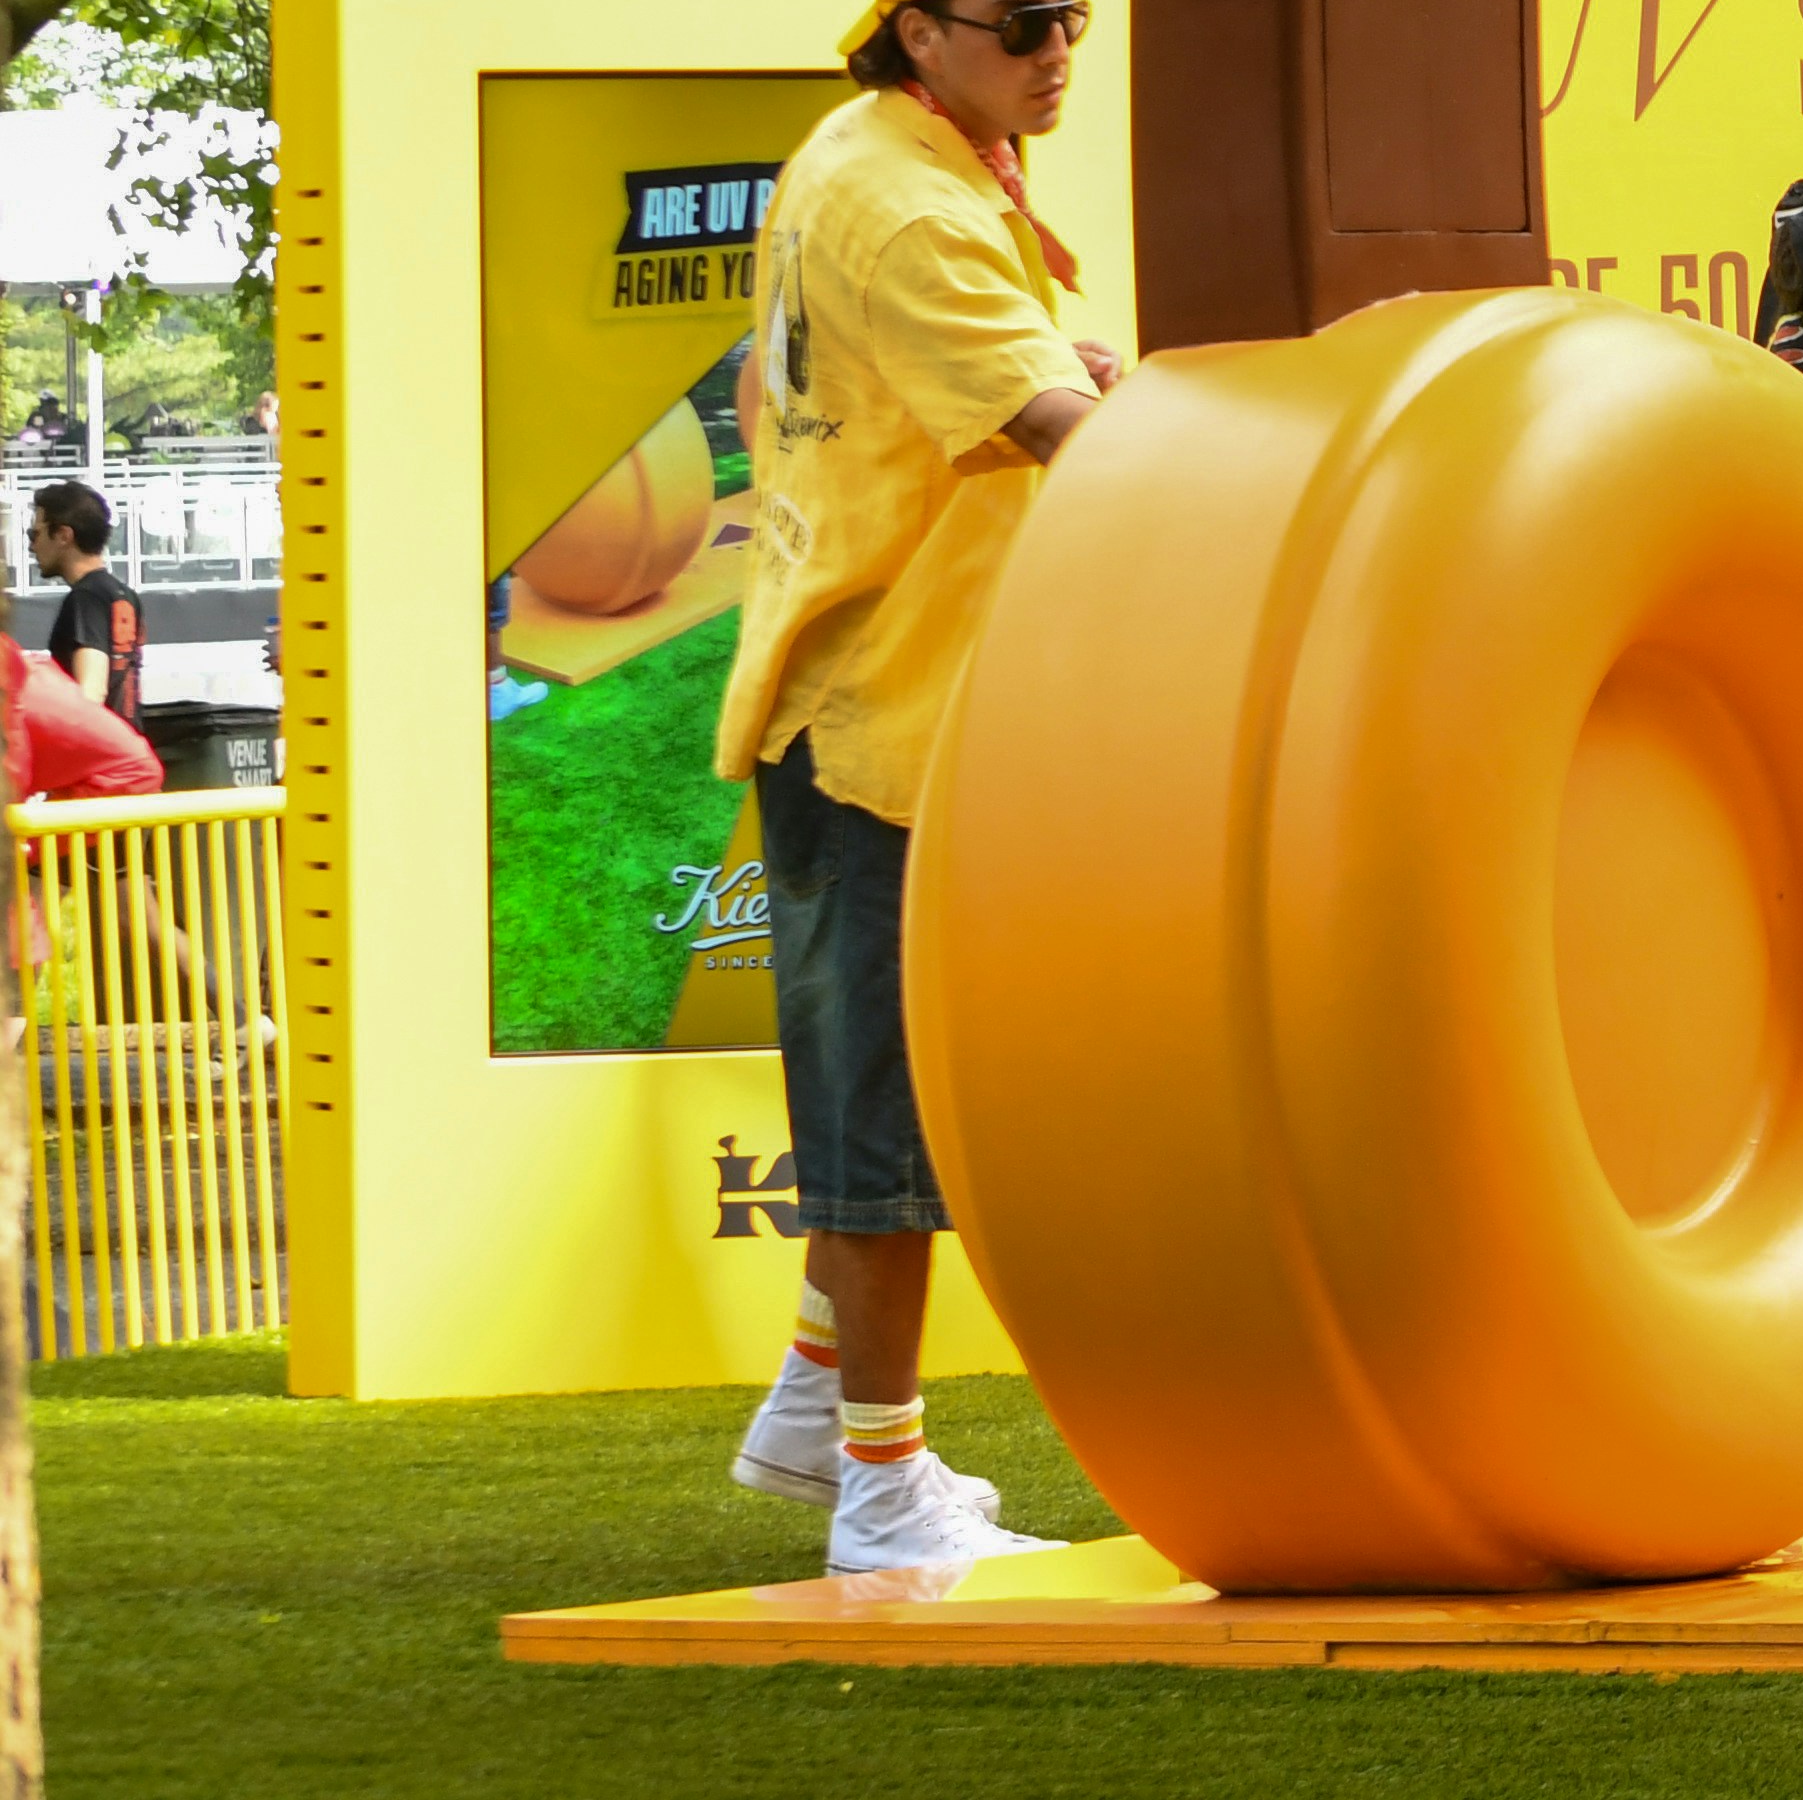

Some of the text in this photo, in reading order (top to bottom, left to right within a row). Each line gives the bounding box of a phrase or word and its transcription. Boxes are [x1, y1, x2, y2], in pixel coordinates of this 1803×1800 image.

[640, 183, 703, 239] ARE
[706, 179, 750, 234] UV
[614, 253, 709, 308] AGING
[226, 738, 267, 768] VENUE
